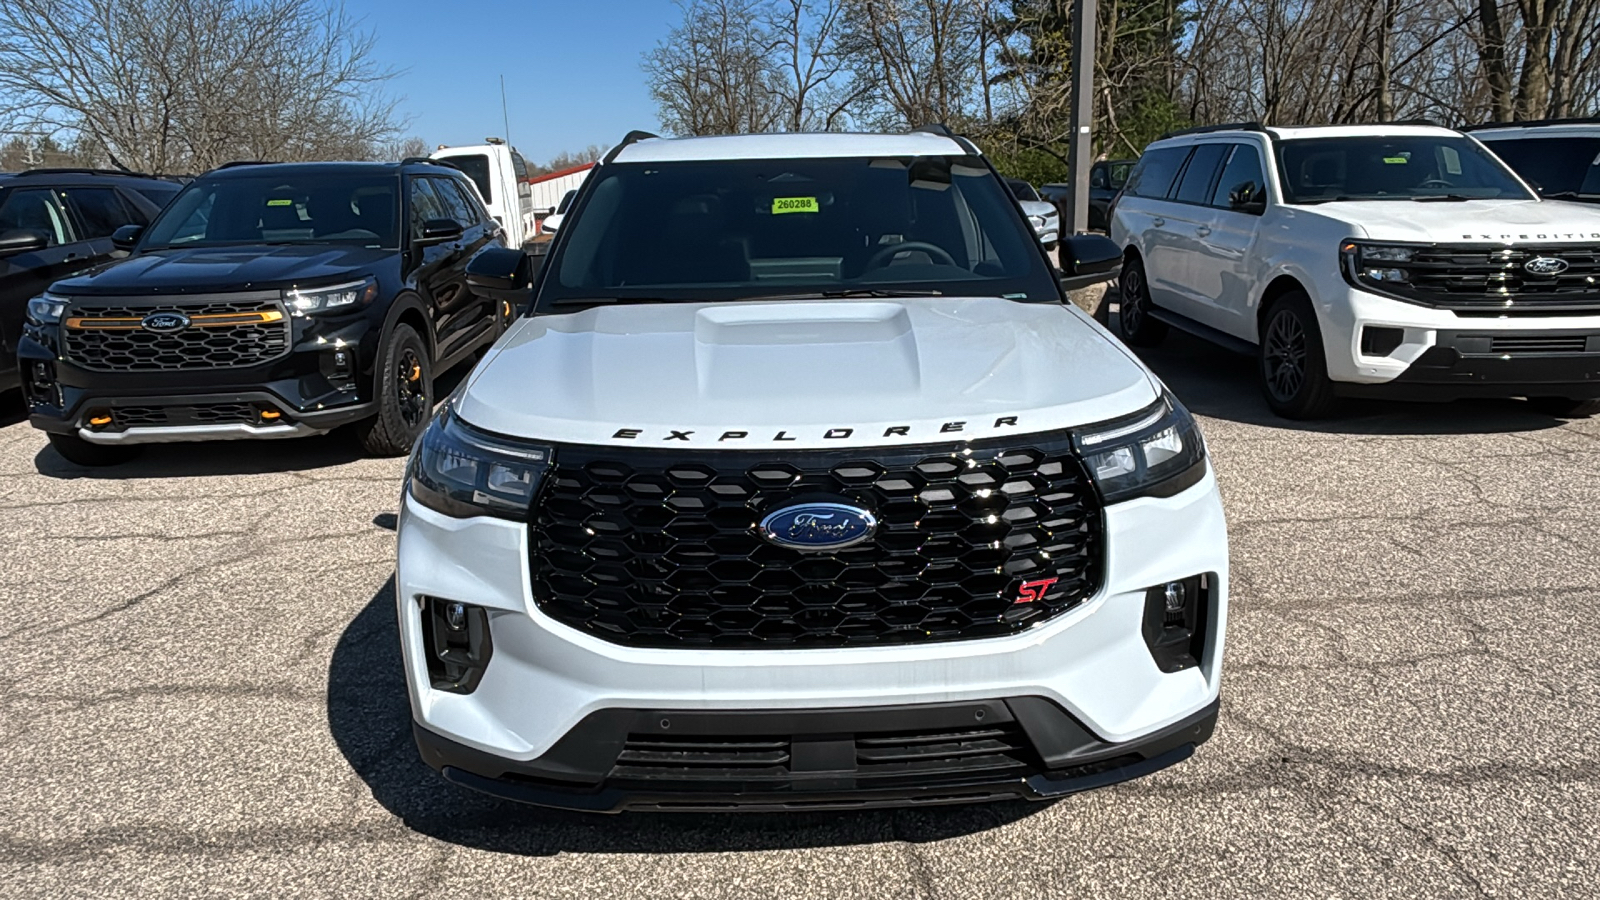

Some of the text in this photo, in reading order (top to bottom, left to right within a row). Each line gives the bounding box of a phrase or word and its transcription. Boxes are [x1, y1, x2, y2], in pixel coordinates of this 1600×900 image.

[777, 199, 812, 209] 260288
[1533, 260, 1561, 272] Ford
[151, 317, 177, 328] Ford
[612, 415, 1019, 442] EXPLORER
[788, 513, 850, 539] Ford
[1013, 576, 1059, 605] ST
